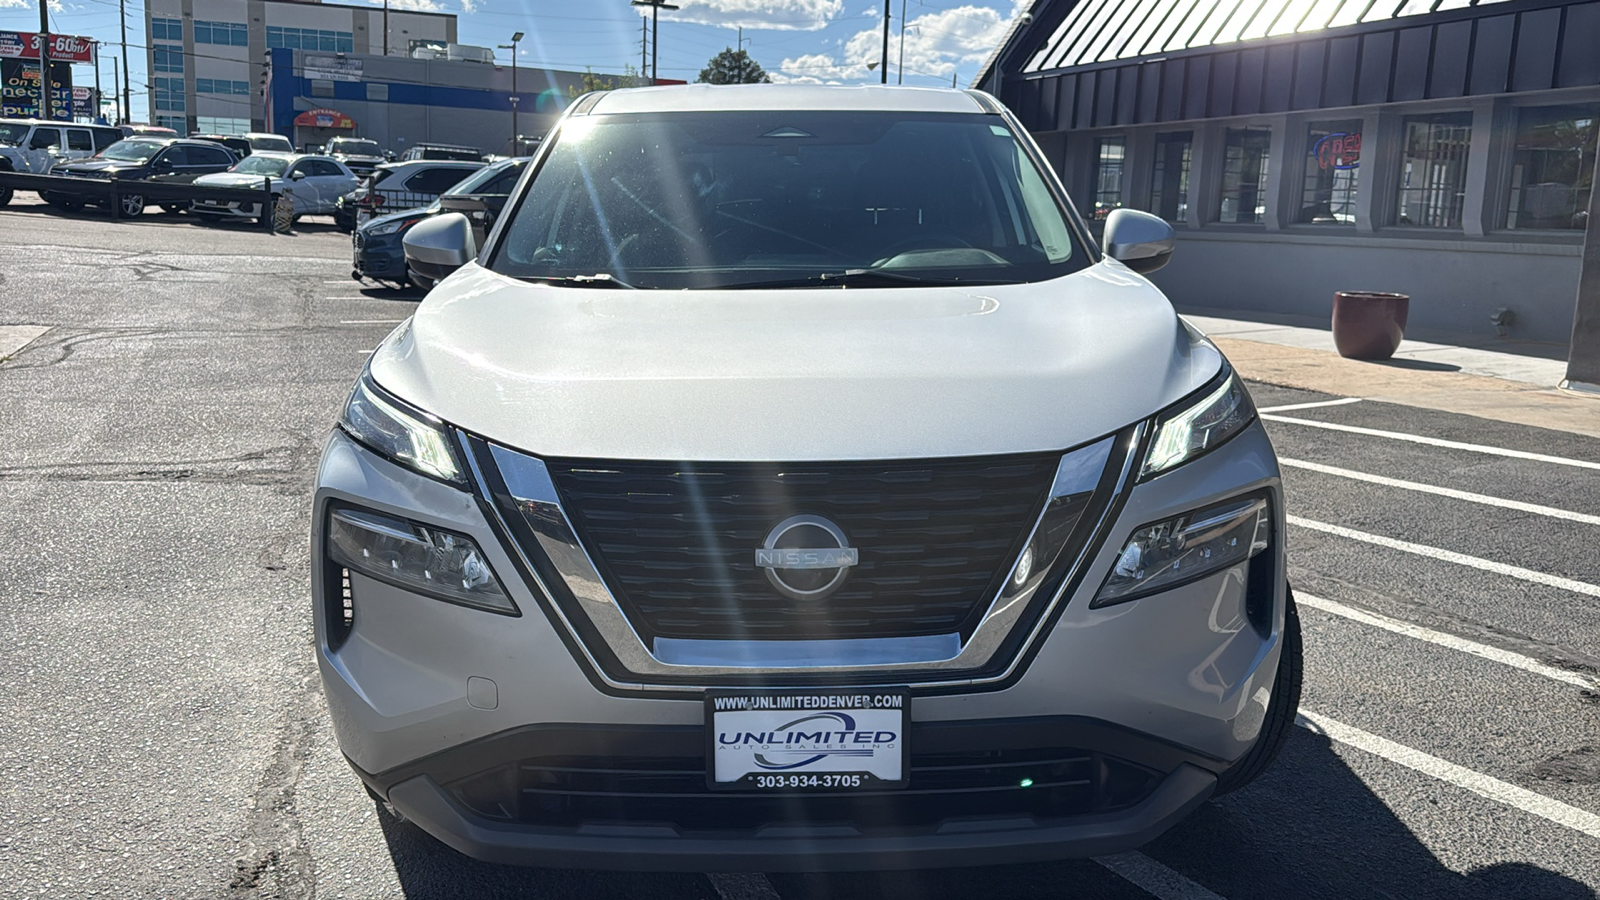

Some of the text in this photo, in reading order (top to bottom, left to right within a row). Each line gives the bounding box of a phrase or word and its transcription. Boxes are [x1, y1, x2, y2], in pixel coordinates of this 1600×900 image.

[9, 78, 61, 88] On Sle
[3, 87, 69, 99] necar
[309, 109, 341, 117] ENTRANCE
[758, 551, 855, 566] NISSAN
[718, 731, 897, 745] UNLIMITED
[756, 775, 861, 789] 303-934-3705
